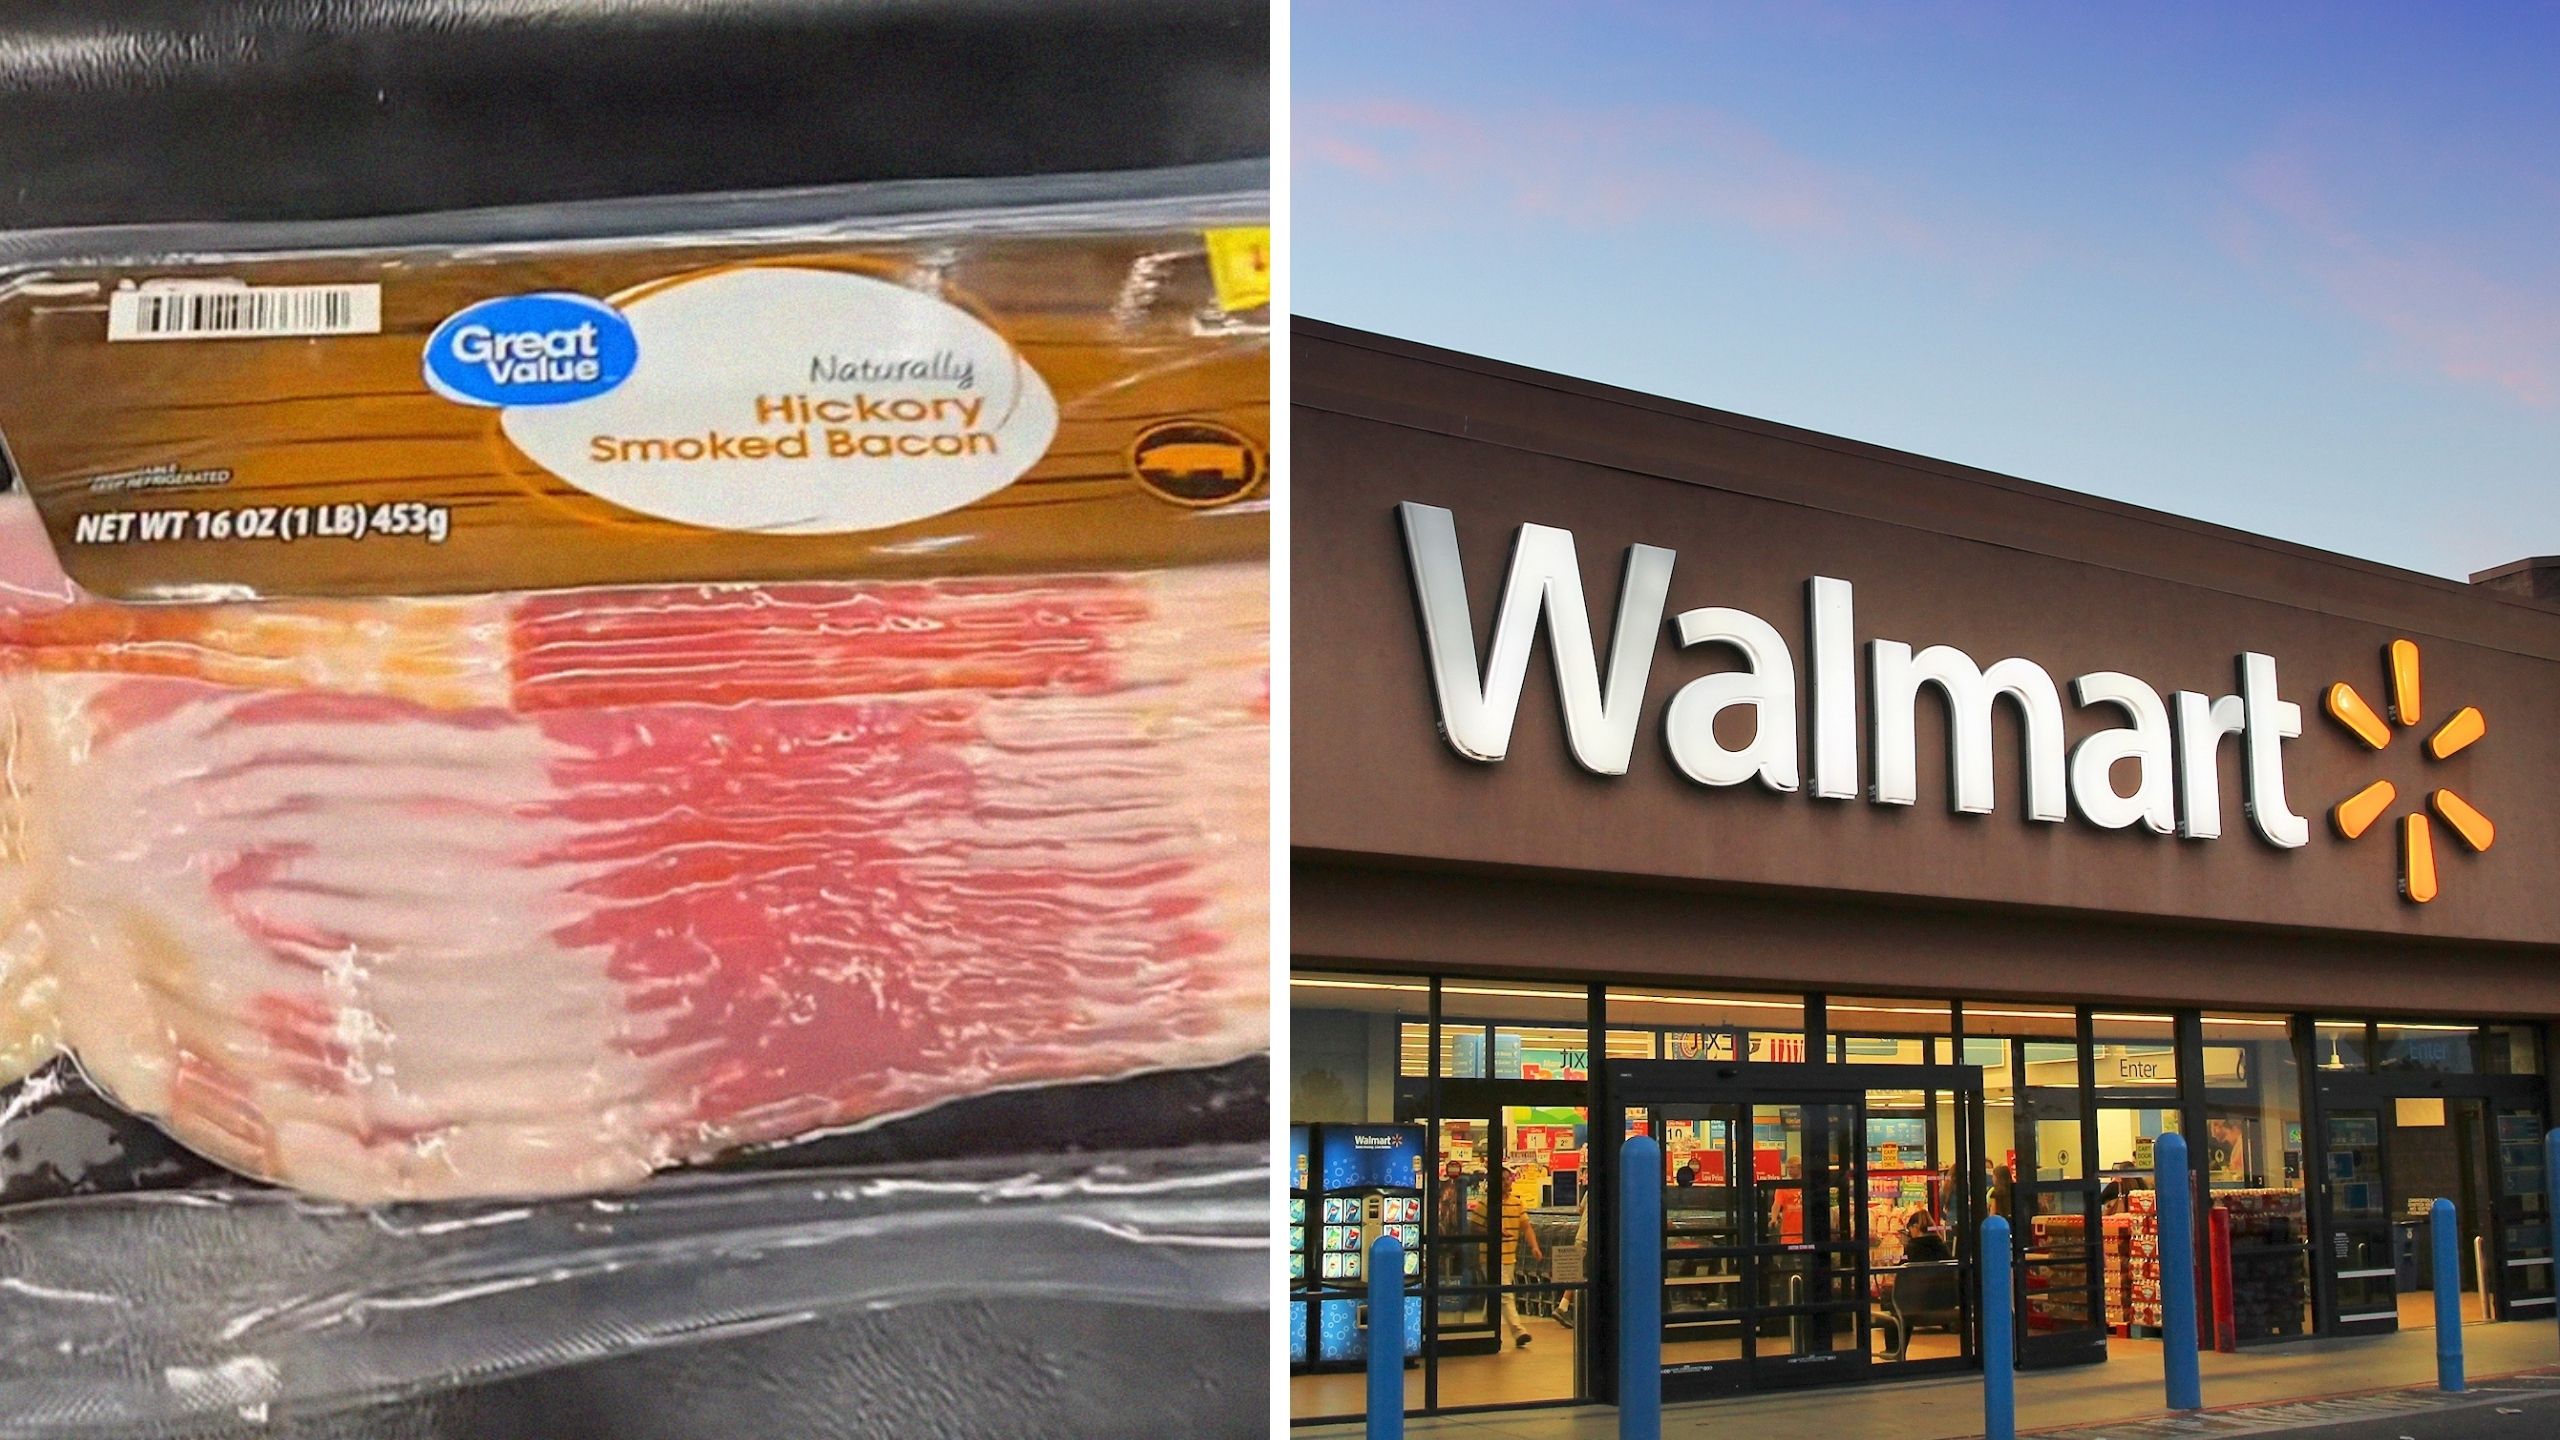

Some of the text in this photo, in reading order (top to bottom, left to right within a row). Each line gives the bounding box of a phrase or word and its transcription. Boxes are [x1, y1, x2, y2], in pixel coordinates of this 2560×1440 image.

[452, 320, 598, 364] Great
[486, 355, 600, 385] Value
[809, 350, 976, 390] Naturally
[754, 393, 987, 429] Hickory
[589, 428, 998, 464] Smoked Bacon
[75, 502, 449, 543] NET WT 16 OZ (1 LB) 453g
[1398, 500, 2310, 848] Walmart
[2120, 1058, 2158, 1078] Enter
[2409, 1039, 2448, 1061] Enter
[1354, 1135, 1392, 1145] Walmart
